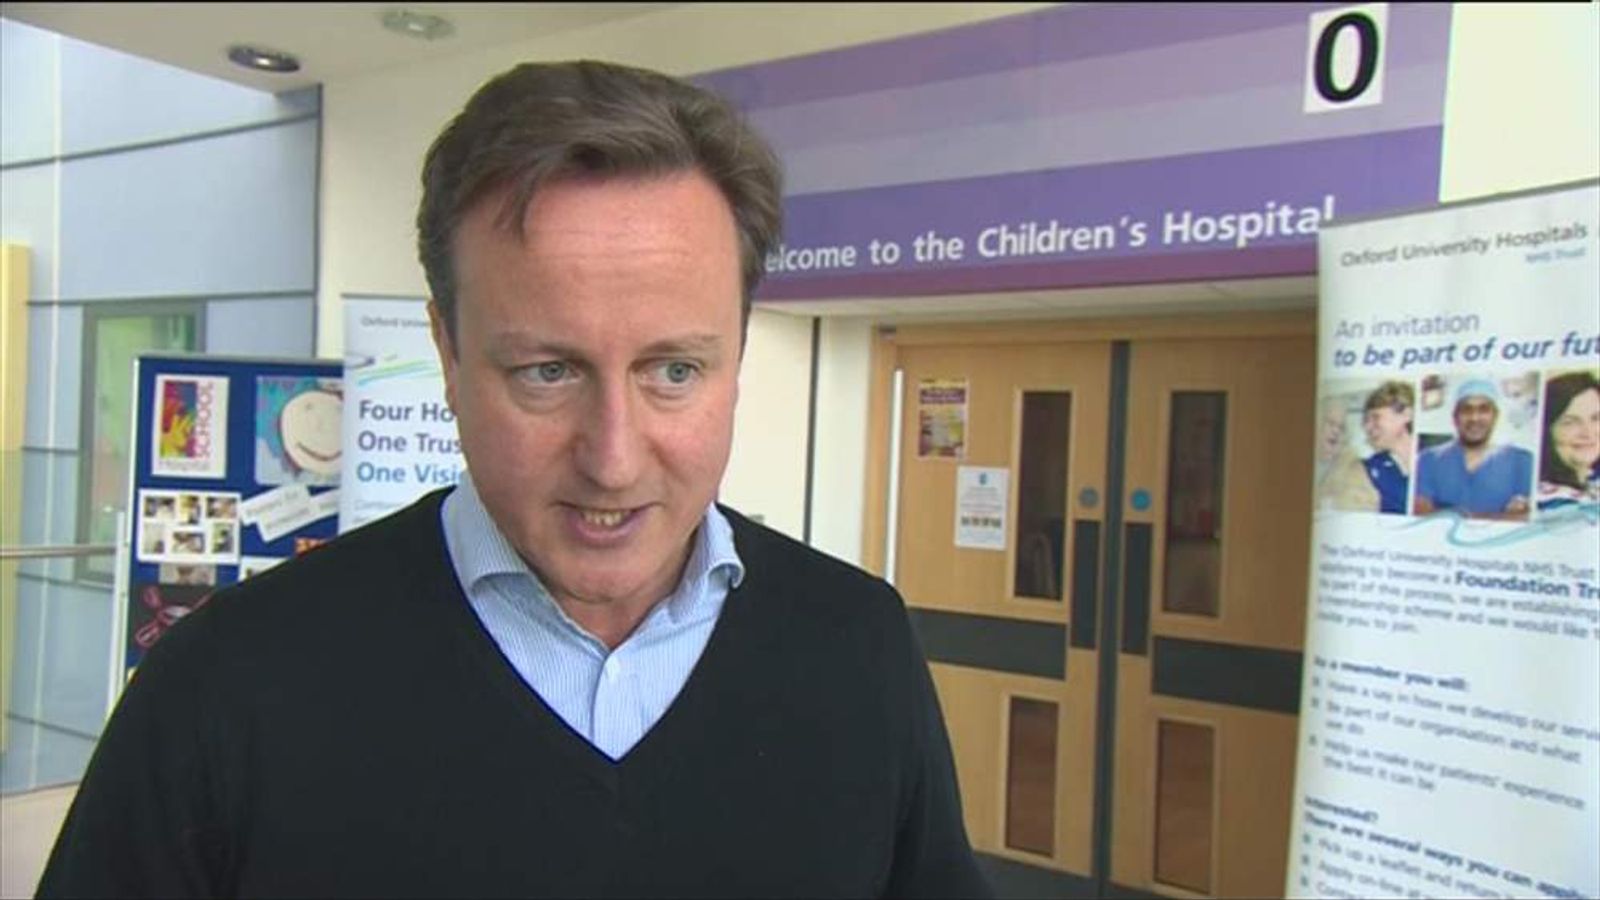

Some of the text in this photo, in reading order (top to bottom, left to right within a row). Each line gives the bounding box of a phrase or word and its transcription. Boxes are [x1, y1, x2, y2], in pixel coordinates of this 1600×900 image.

[869, 239, 900, 265] to
[913, 231, 964, 262] the
[977, 214, 1147, 258] Children's
[1162, 195, 1335, 248] Hospital
[1340, 222, 1588, 267] Oxford University Hospitals
[1334, 313, 1480, 339] An invitation
[1334, 348, 1355, 367] to
[1363, 343, 1394, 366] be
[1400, 342, 1455, 370] part
[1463, 337, 1497, 362] of
[1502, 340, 1553, 361] our
[195, 382, 214, 458] SCHOOL
[359, 400, 456, 422] Four Ho
[357, 430, 407, 452] One
[356, 461, 463, 484] One Visi
[1390, 549, 1452, 568] University
[1457, 555, 1518, 572] Hospitals
[1455, 570, 1570, 598] Foundation
